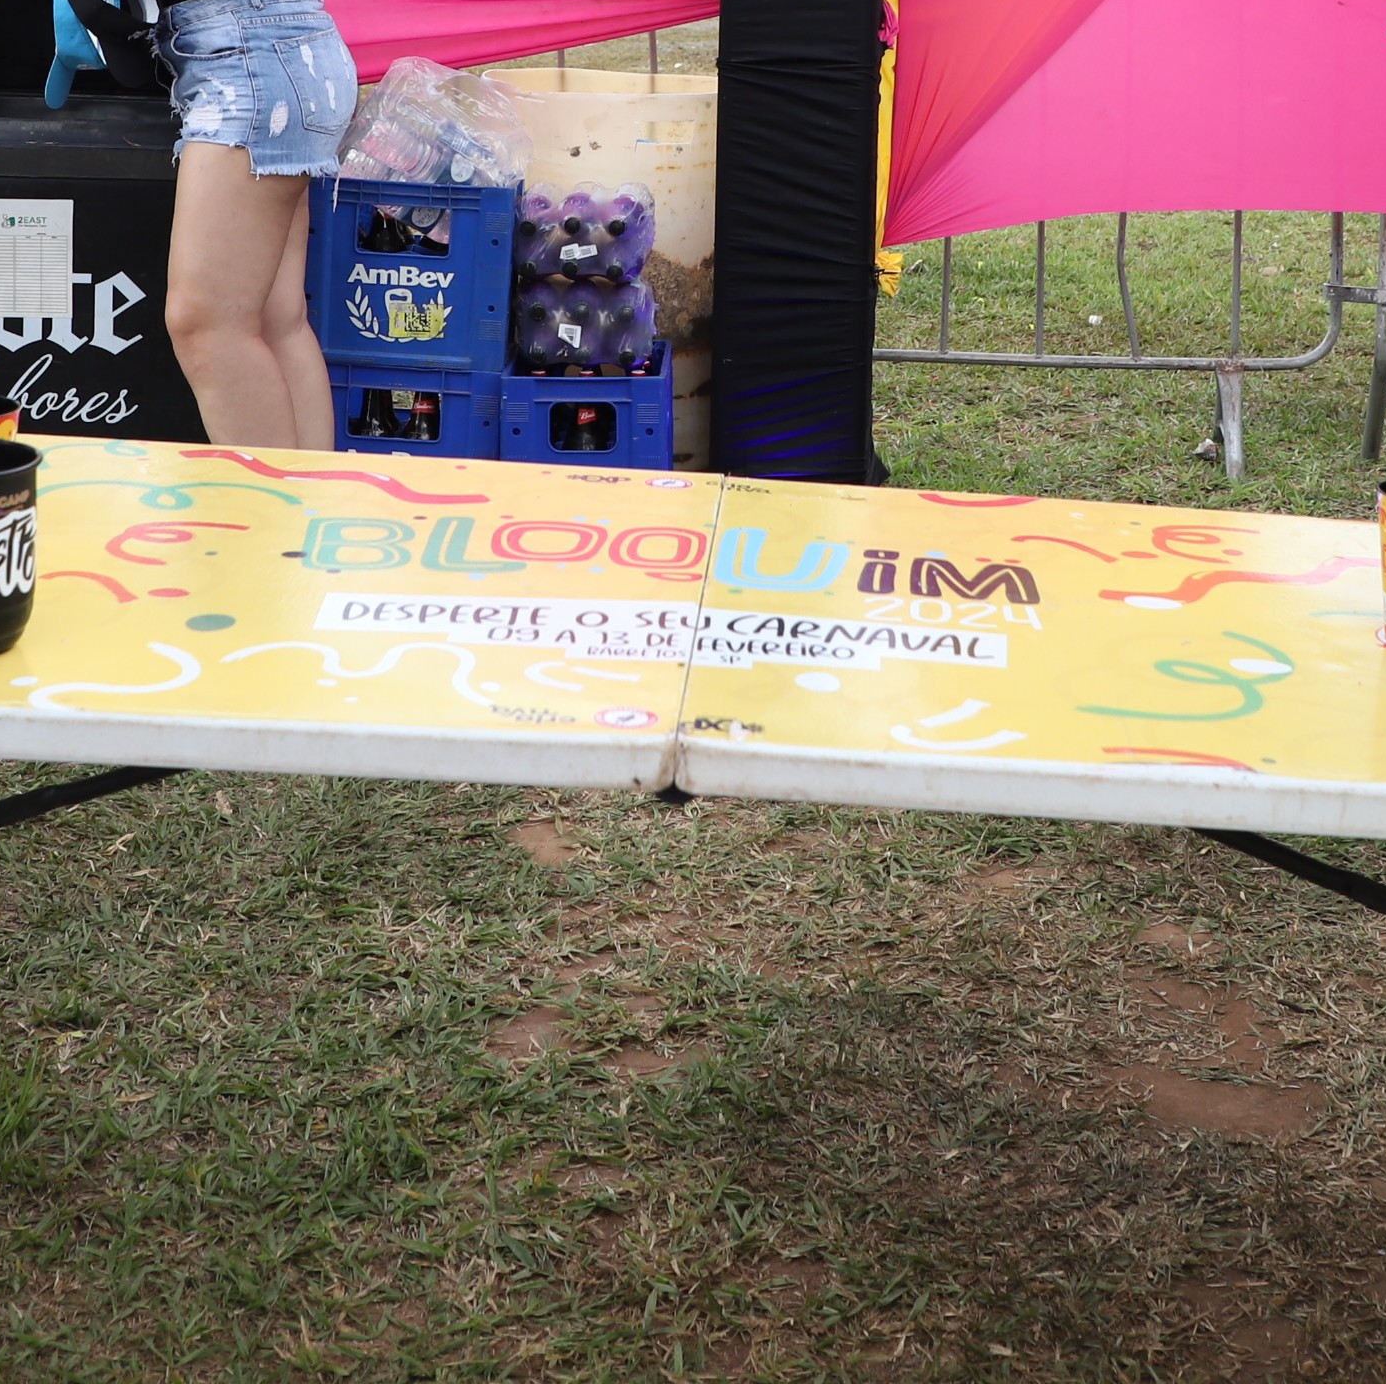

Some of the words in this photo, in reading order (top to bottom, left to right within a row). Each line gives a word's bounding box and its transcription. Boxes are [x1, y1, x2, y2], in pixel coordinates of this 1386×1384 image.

[17, 216, 48, 224] 2EAST
[347, 263, 455, 289] AmBev
[863, 595, 1044, 630] 2024
[341, 600, 552, 626] DESPERTE
[575, 610, 609, 628] O
[634, 609, 711, 631] SEU
[726, 614, 996, 660] CARNAVAL
[486, 626, 540, 642] 09
[555, 628, 576, 645] A
[601, 630, 629, 645] 13
[646, 632, 680, 647] DE
[696, 636, 856, 660] FEVEREIRO
[587, 646, 687, 659] BARRETOS
[719, 654, 742, 665] SP
